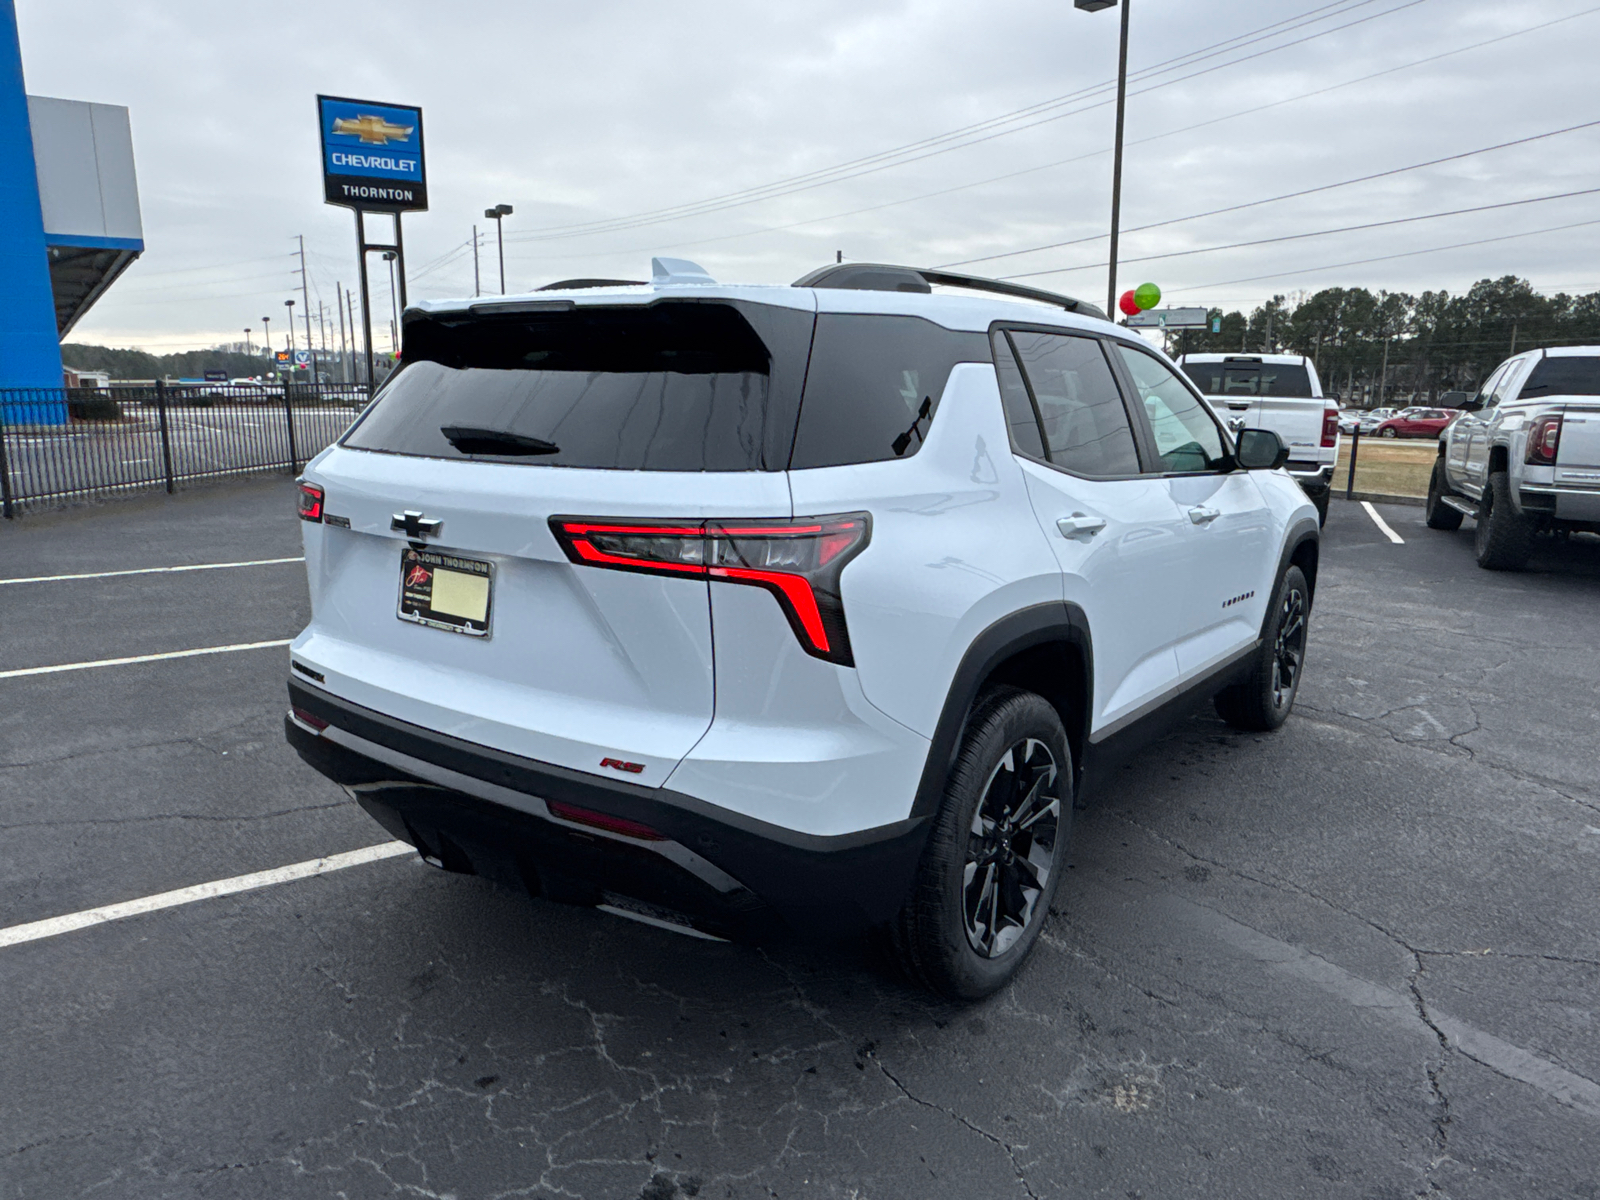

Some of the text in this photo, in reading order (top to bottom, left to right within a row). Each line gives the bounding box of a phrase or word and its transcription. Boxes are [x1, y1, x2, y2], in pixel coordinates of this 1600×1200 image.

[332, 153, 416, 172] CHEVROLET
[342, 185, 413, 201] THORNTON
[421, 552, 442, 565] JOHN
[599, 757, 646, 773] RS
